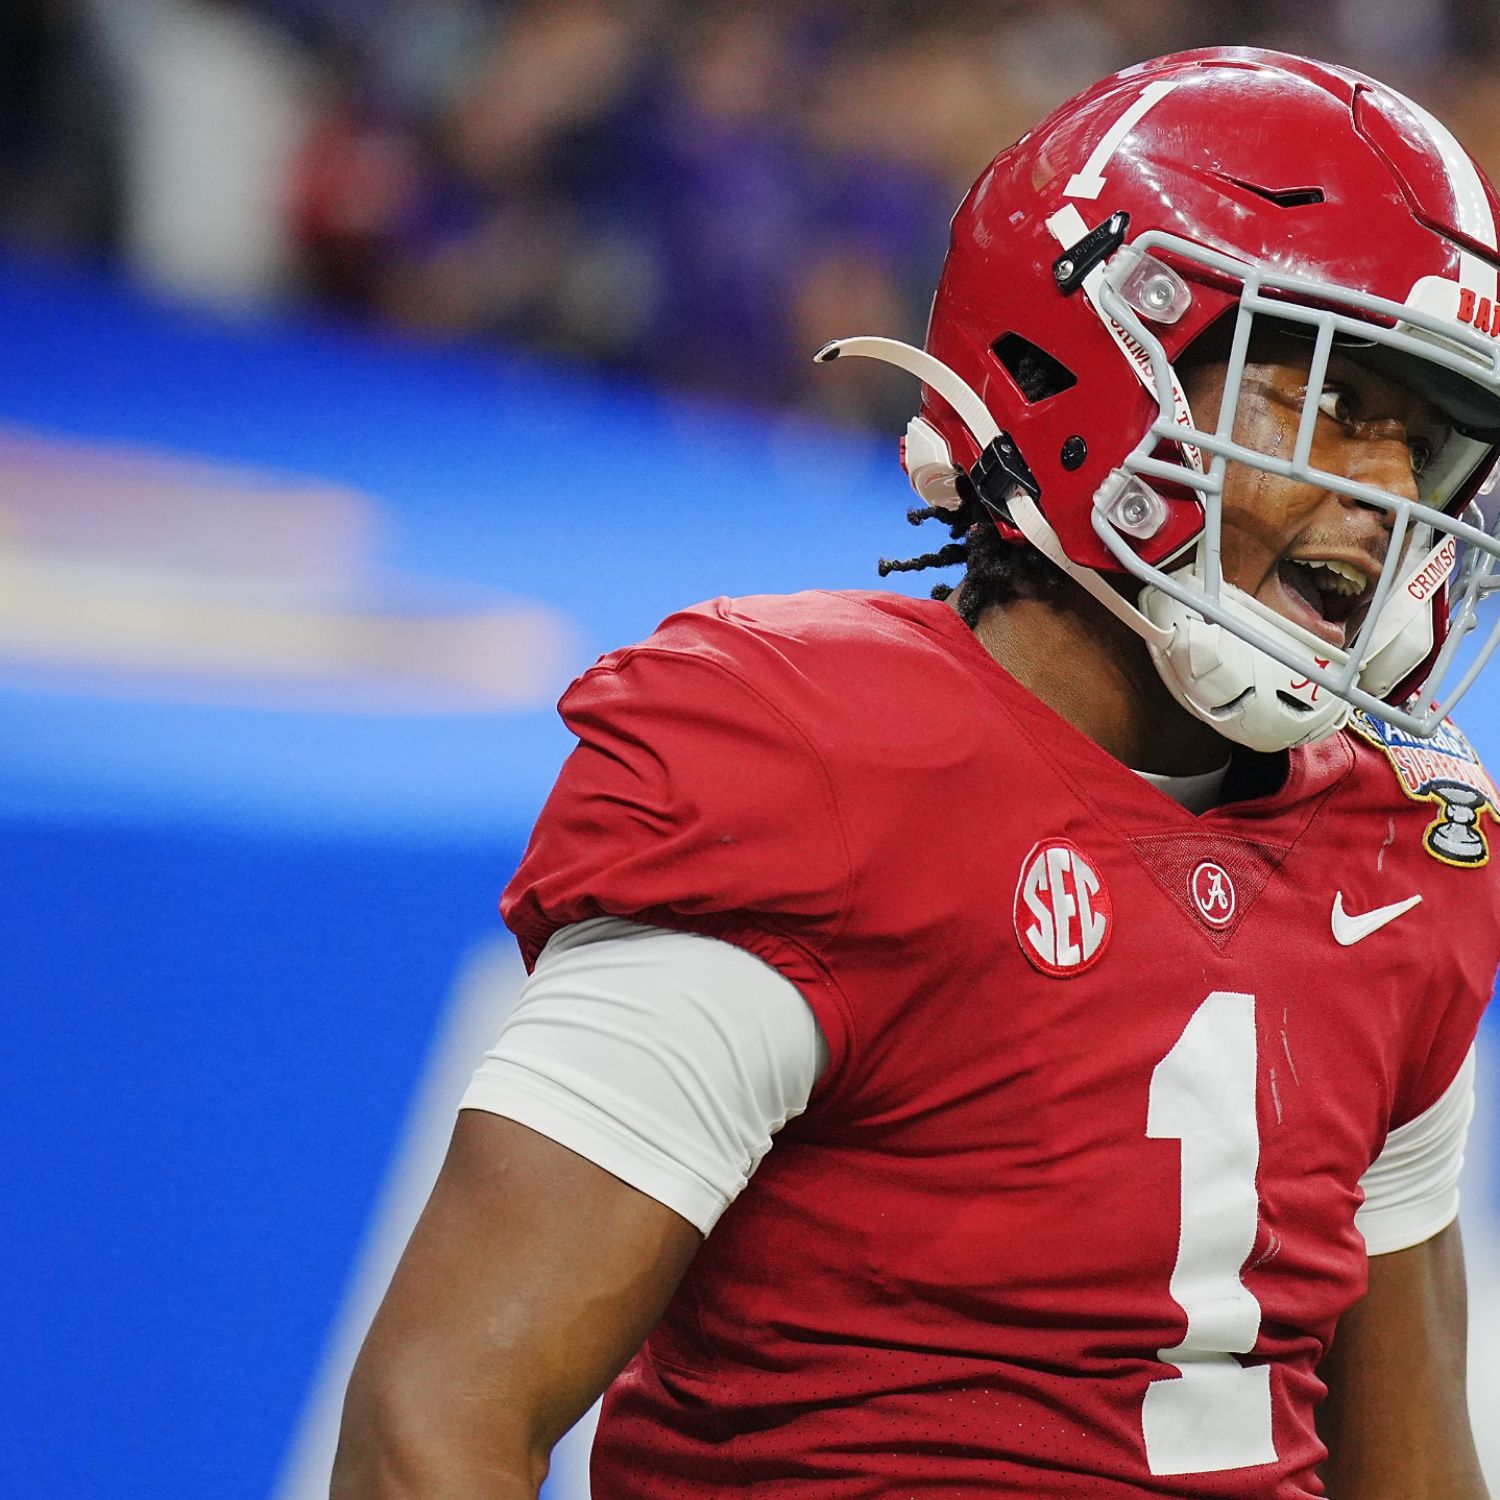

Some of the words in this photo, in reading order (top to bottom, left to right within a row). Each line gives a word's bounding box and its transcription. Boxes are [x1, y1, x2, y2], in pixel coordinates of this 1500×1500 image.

[1062, 80, 1180, 200] 1
[1110, 316, 1183, 404] RIMSN
[1407, 535, 1457, 600] CRIMSO
[1023, 848, 1107, 966] SEC
[1141, 991, 1279, 1476] 1
